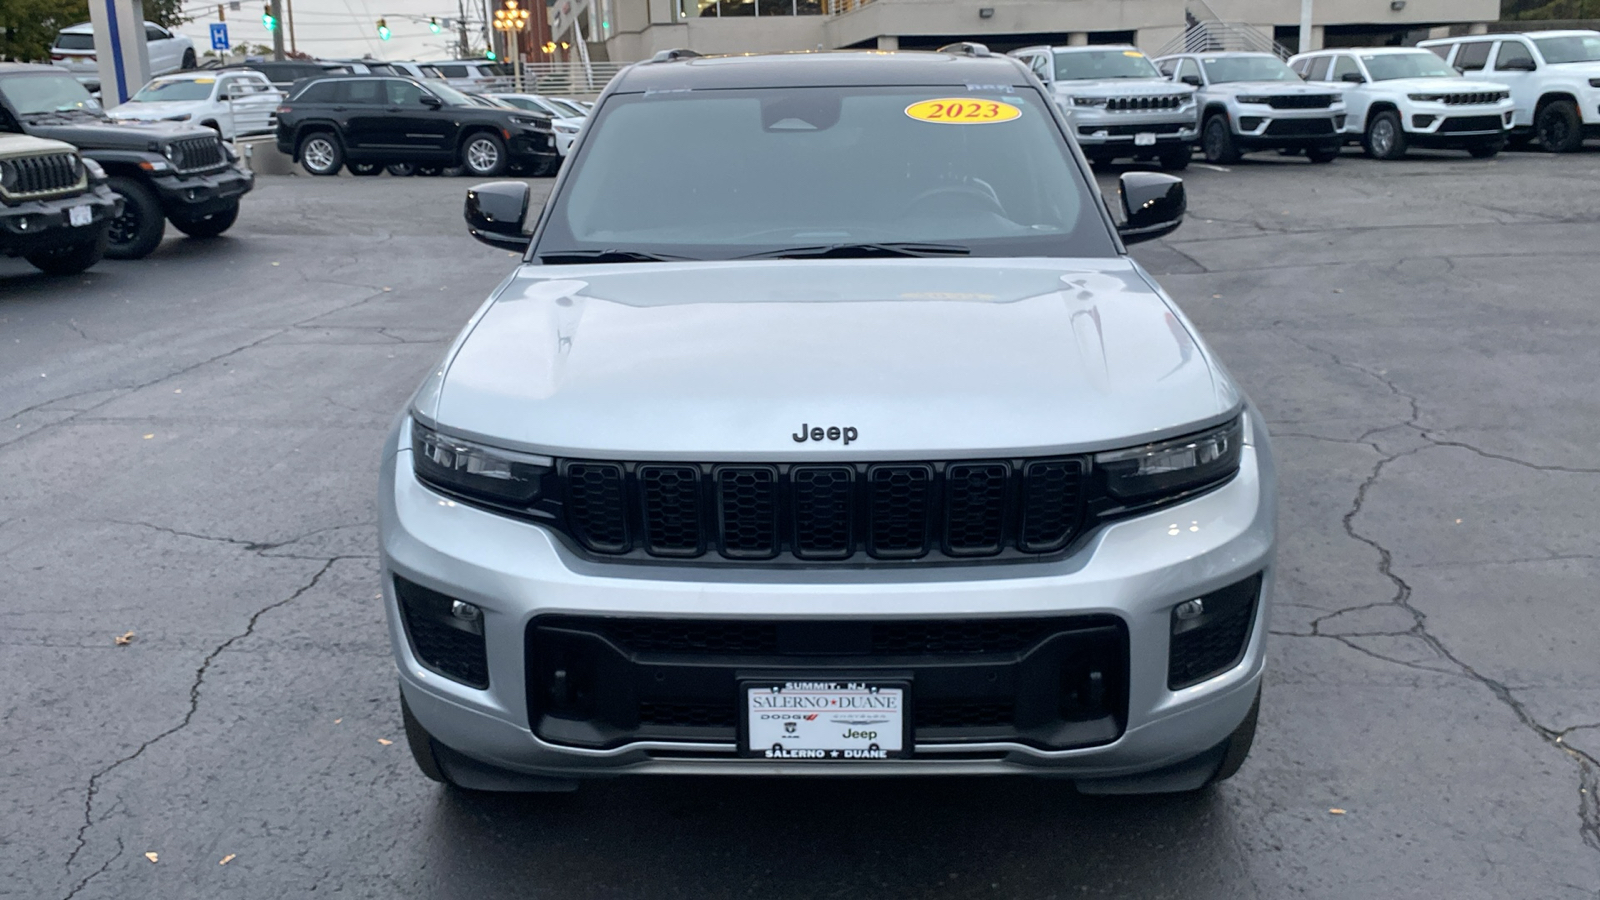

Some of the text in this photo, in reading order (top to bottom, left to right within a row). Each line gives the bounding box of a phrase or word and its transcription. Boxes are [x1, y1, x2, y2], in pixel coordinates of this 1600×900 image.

[213, 29, 225, 42] H
[926, 103, 1000, 119] 2023
[792, 423, 858, 445] Jeep
[847, 682, 866, 690] NJ
[753, 696, 897, 709] SALERNO DUANE
[842, 728, 877, 740] Jeep
[765, 749, 887, 758] SALERNO DUANE
